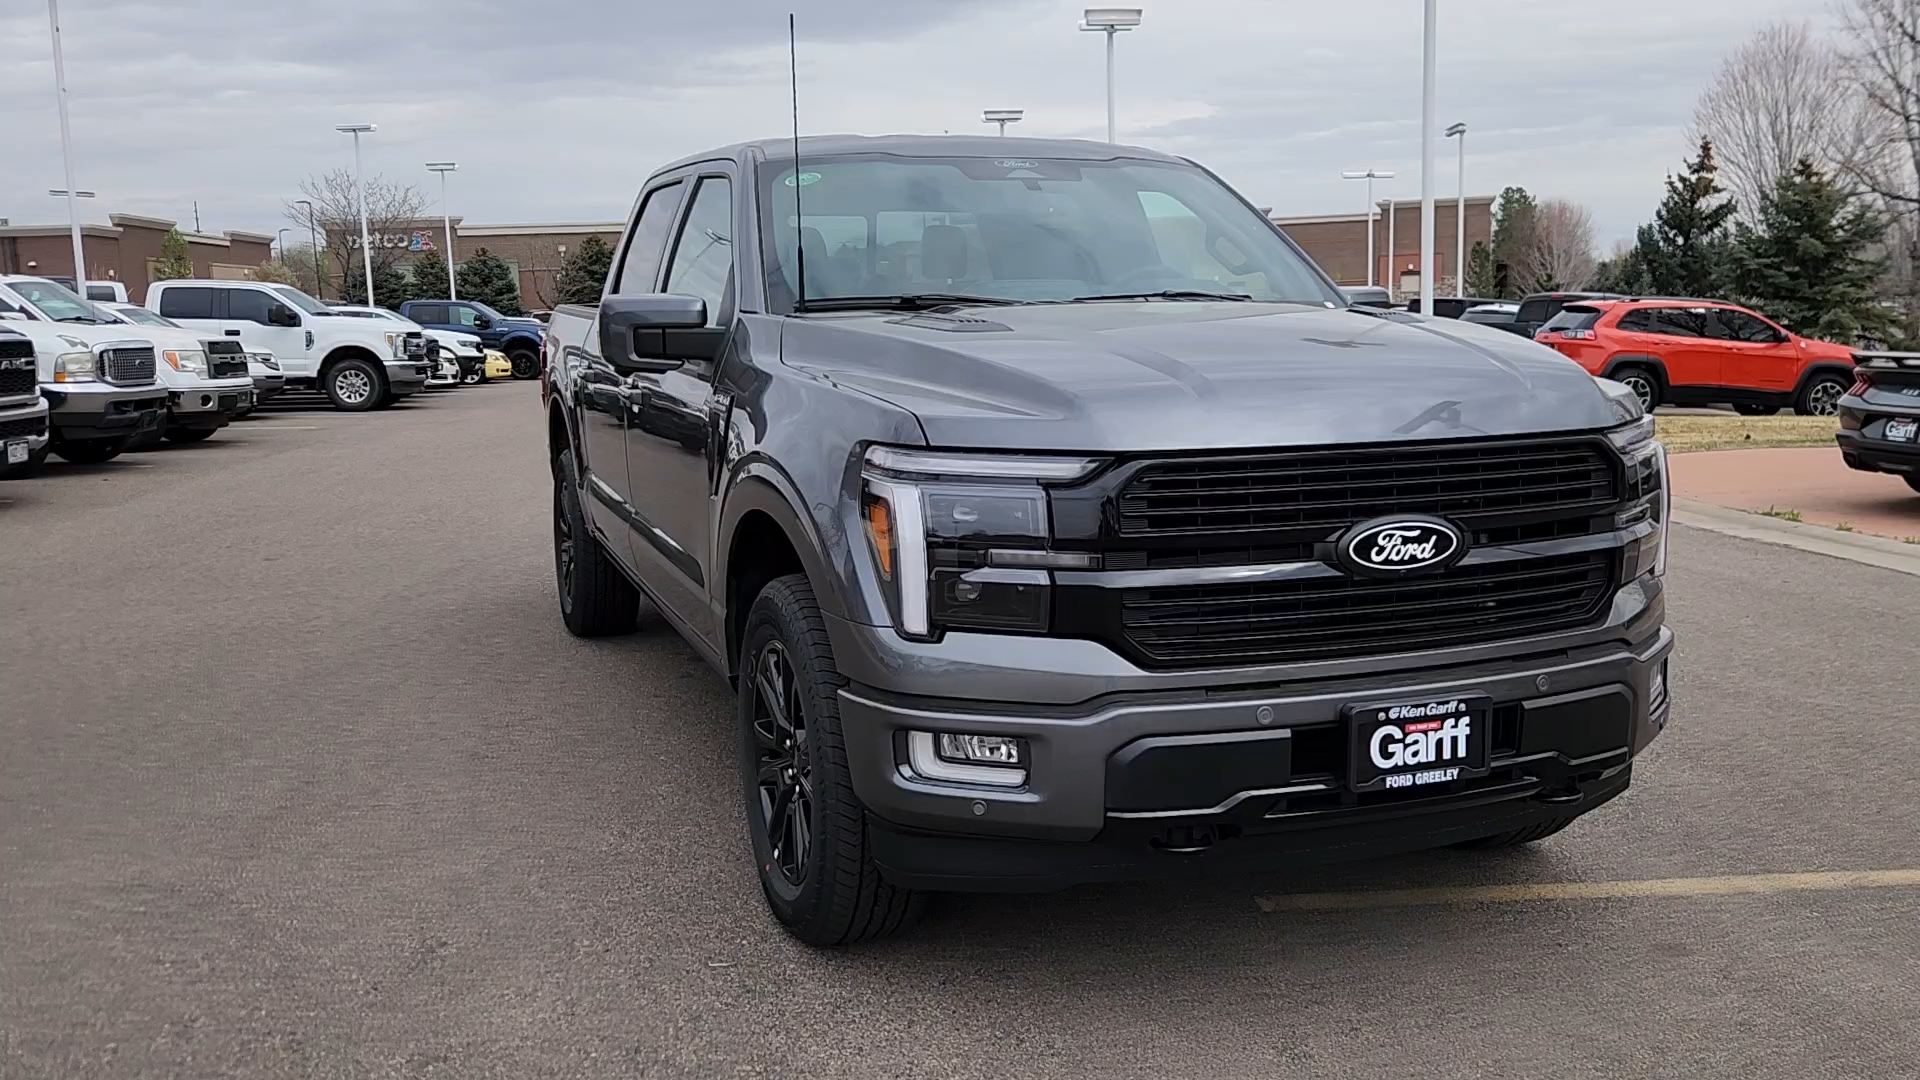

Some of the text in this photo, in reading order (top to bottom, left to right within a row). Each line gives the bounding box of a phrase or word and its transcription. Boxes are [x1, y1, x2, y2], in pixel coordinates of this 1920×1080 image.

[0, 359, 26, 370] AM
[1370, 529, 1438, 563] Ford
[1400, 700, 1458, 719] Ken Garff
[1370, 715, 1471, 769] Garff
[1385, 768, 1460, 789] FORD GREELEY
